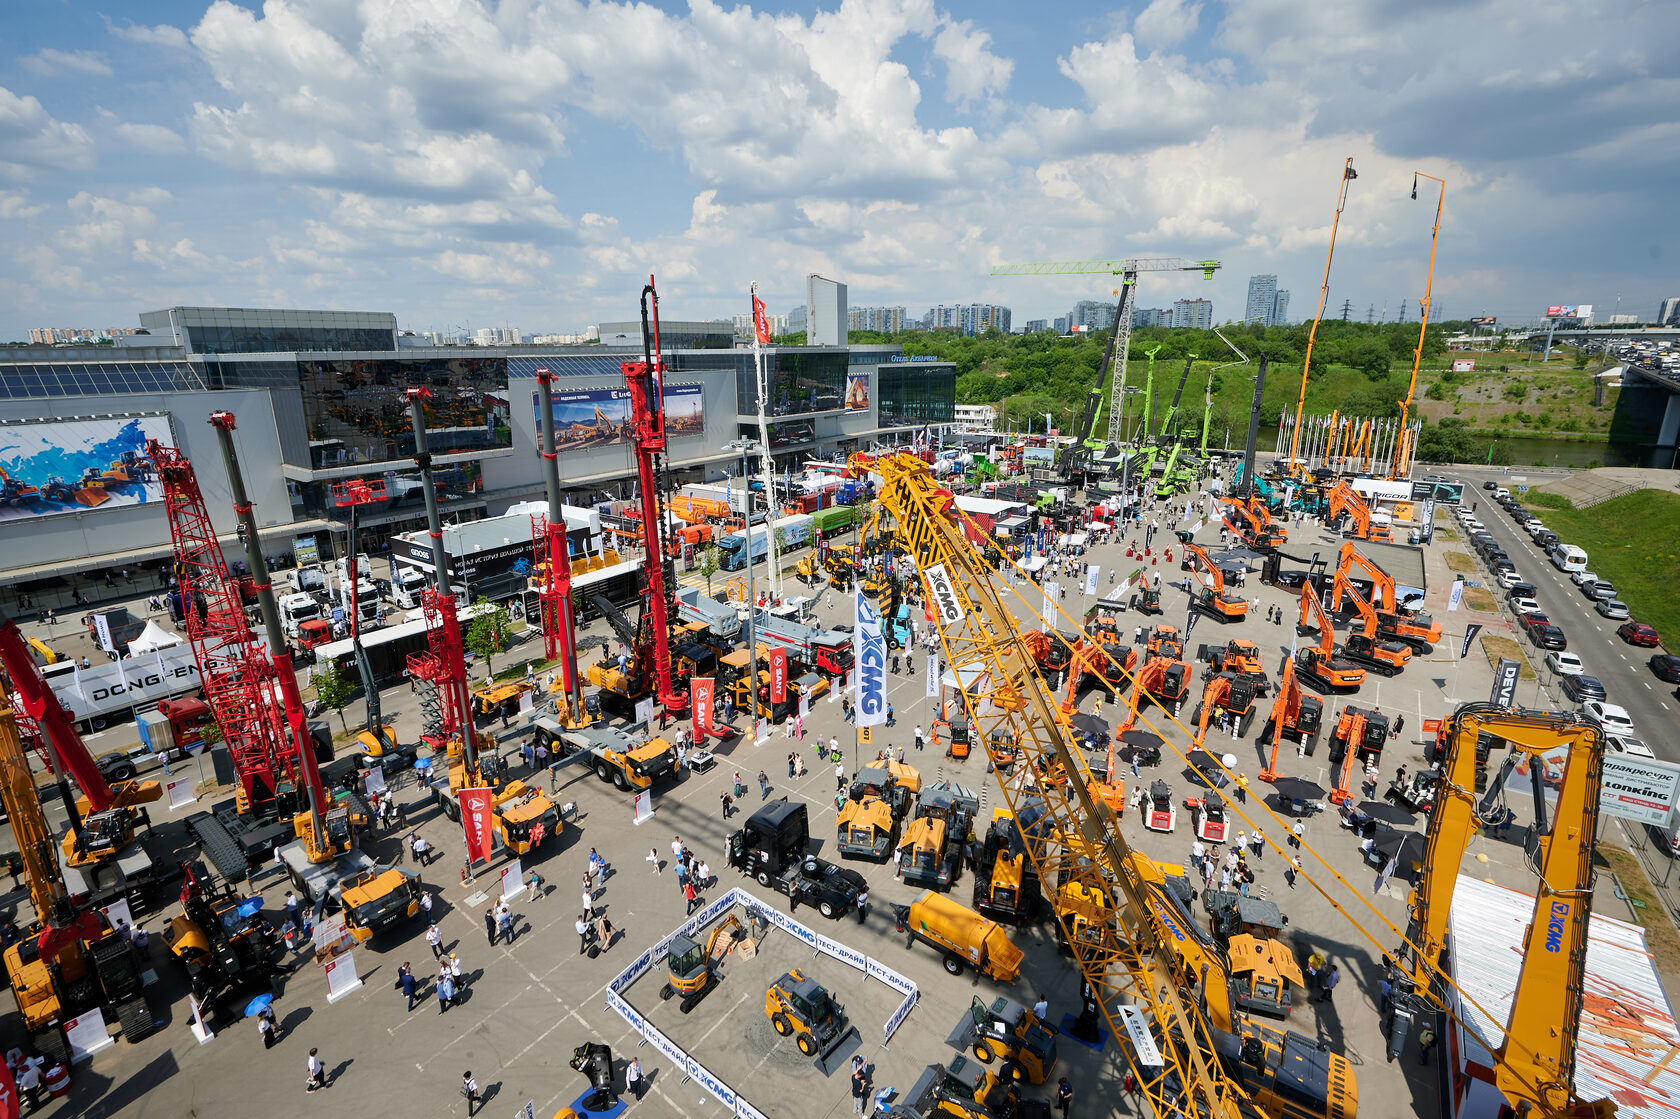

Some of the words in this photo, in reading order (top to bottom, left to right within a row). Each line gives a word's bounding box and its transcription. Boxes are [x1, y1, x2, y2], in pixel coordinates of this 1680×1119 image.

[411, 548, 429, 559] GROSS
[929, 570, 958, 621] XCMG
[861, 627, 883, 715] XCMG
[1499, 667, 1516, 707] DEVE
[709, 892, 735, 917] XCMG
[785, 920, 816, 943] XCMG
[1160, 911, 1186, 941] XCMG
[1545, 913, 1566, 953] XCMG
[819, 939, 864, 965] ТЕСТ-ДРАЙВ
[620, 954, 651, 987] XCMG
[617, 1001, 642, 1030] XCMG
[645, 1026, 686, 1065] ТЕСТ-ДРАЙВ
[699, 1073, 735, 1106] XCMG
